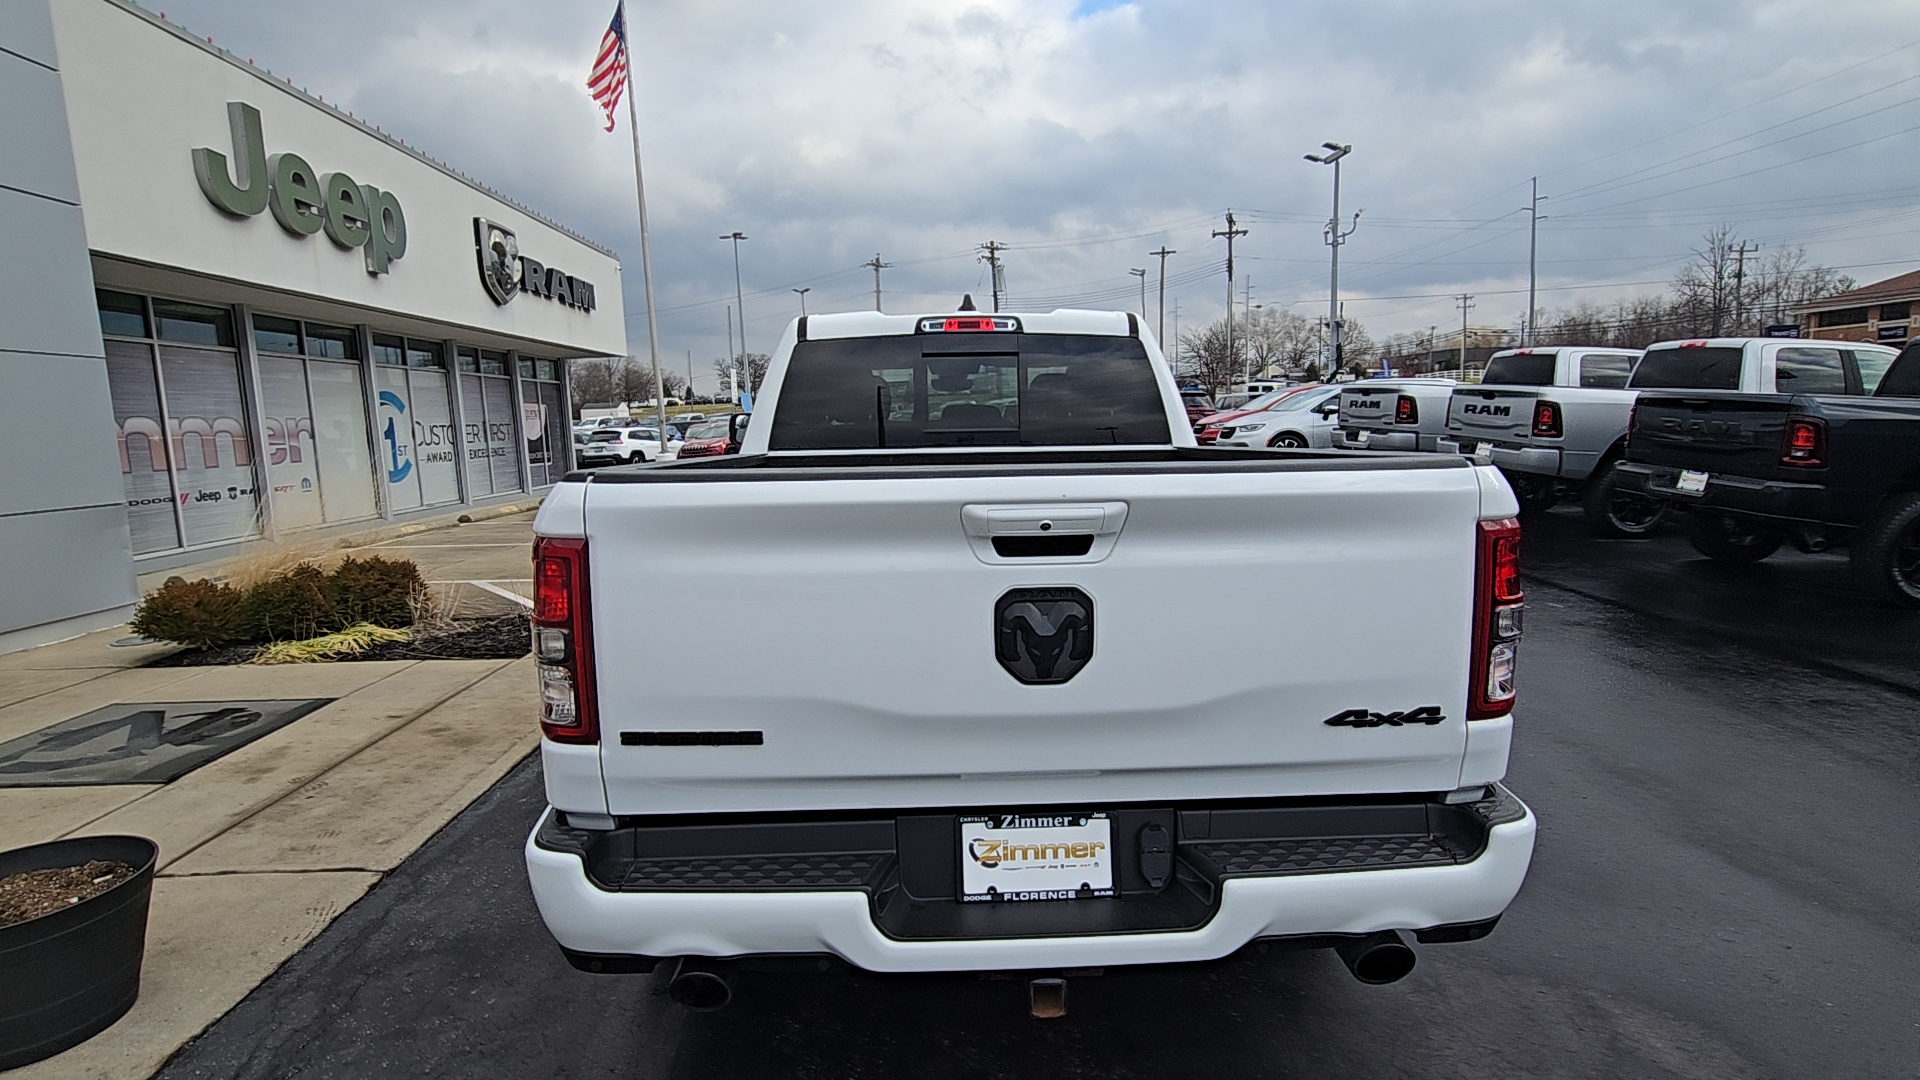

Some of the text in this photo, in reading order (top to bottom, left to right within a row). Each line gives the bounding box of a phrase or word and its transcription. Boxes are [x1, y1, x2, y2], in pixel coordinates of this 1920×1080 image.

[191, 101, 407, 276] Jeep
[518, 255, 597, 313] RAM
[1349, 400, 1382, 409] RAM
[1463, 403, 1512, 417] RAM
[411, 420, 512, 448] CUSTOER RST
[426, 447, 507, 464] AWARD EXCELENCE
[128, 496, 176, 507] DODG
[195, 489, 222, 503] Jeep
[1323, 706, 1446, 728] 4x4
[1000, 814, 1072, 829] Zimmer
[977, 839, 1106, 862] Zimmer
[1003, 891, 1076, 901] FLORENCE
